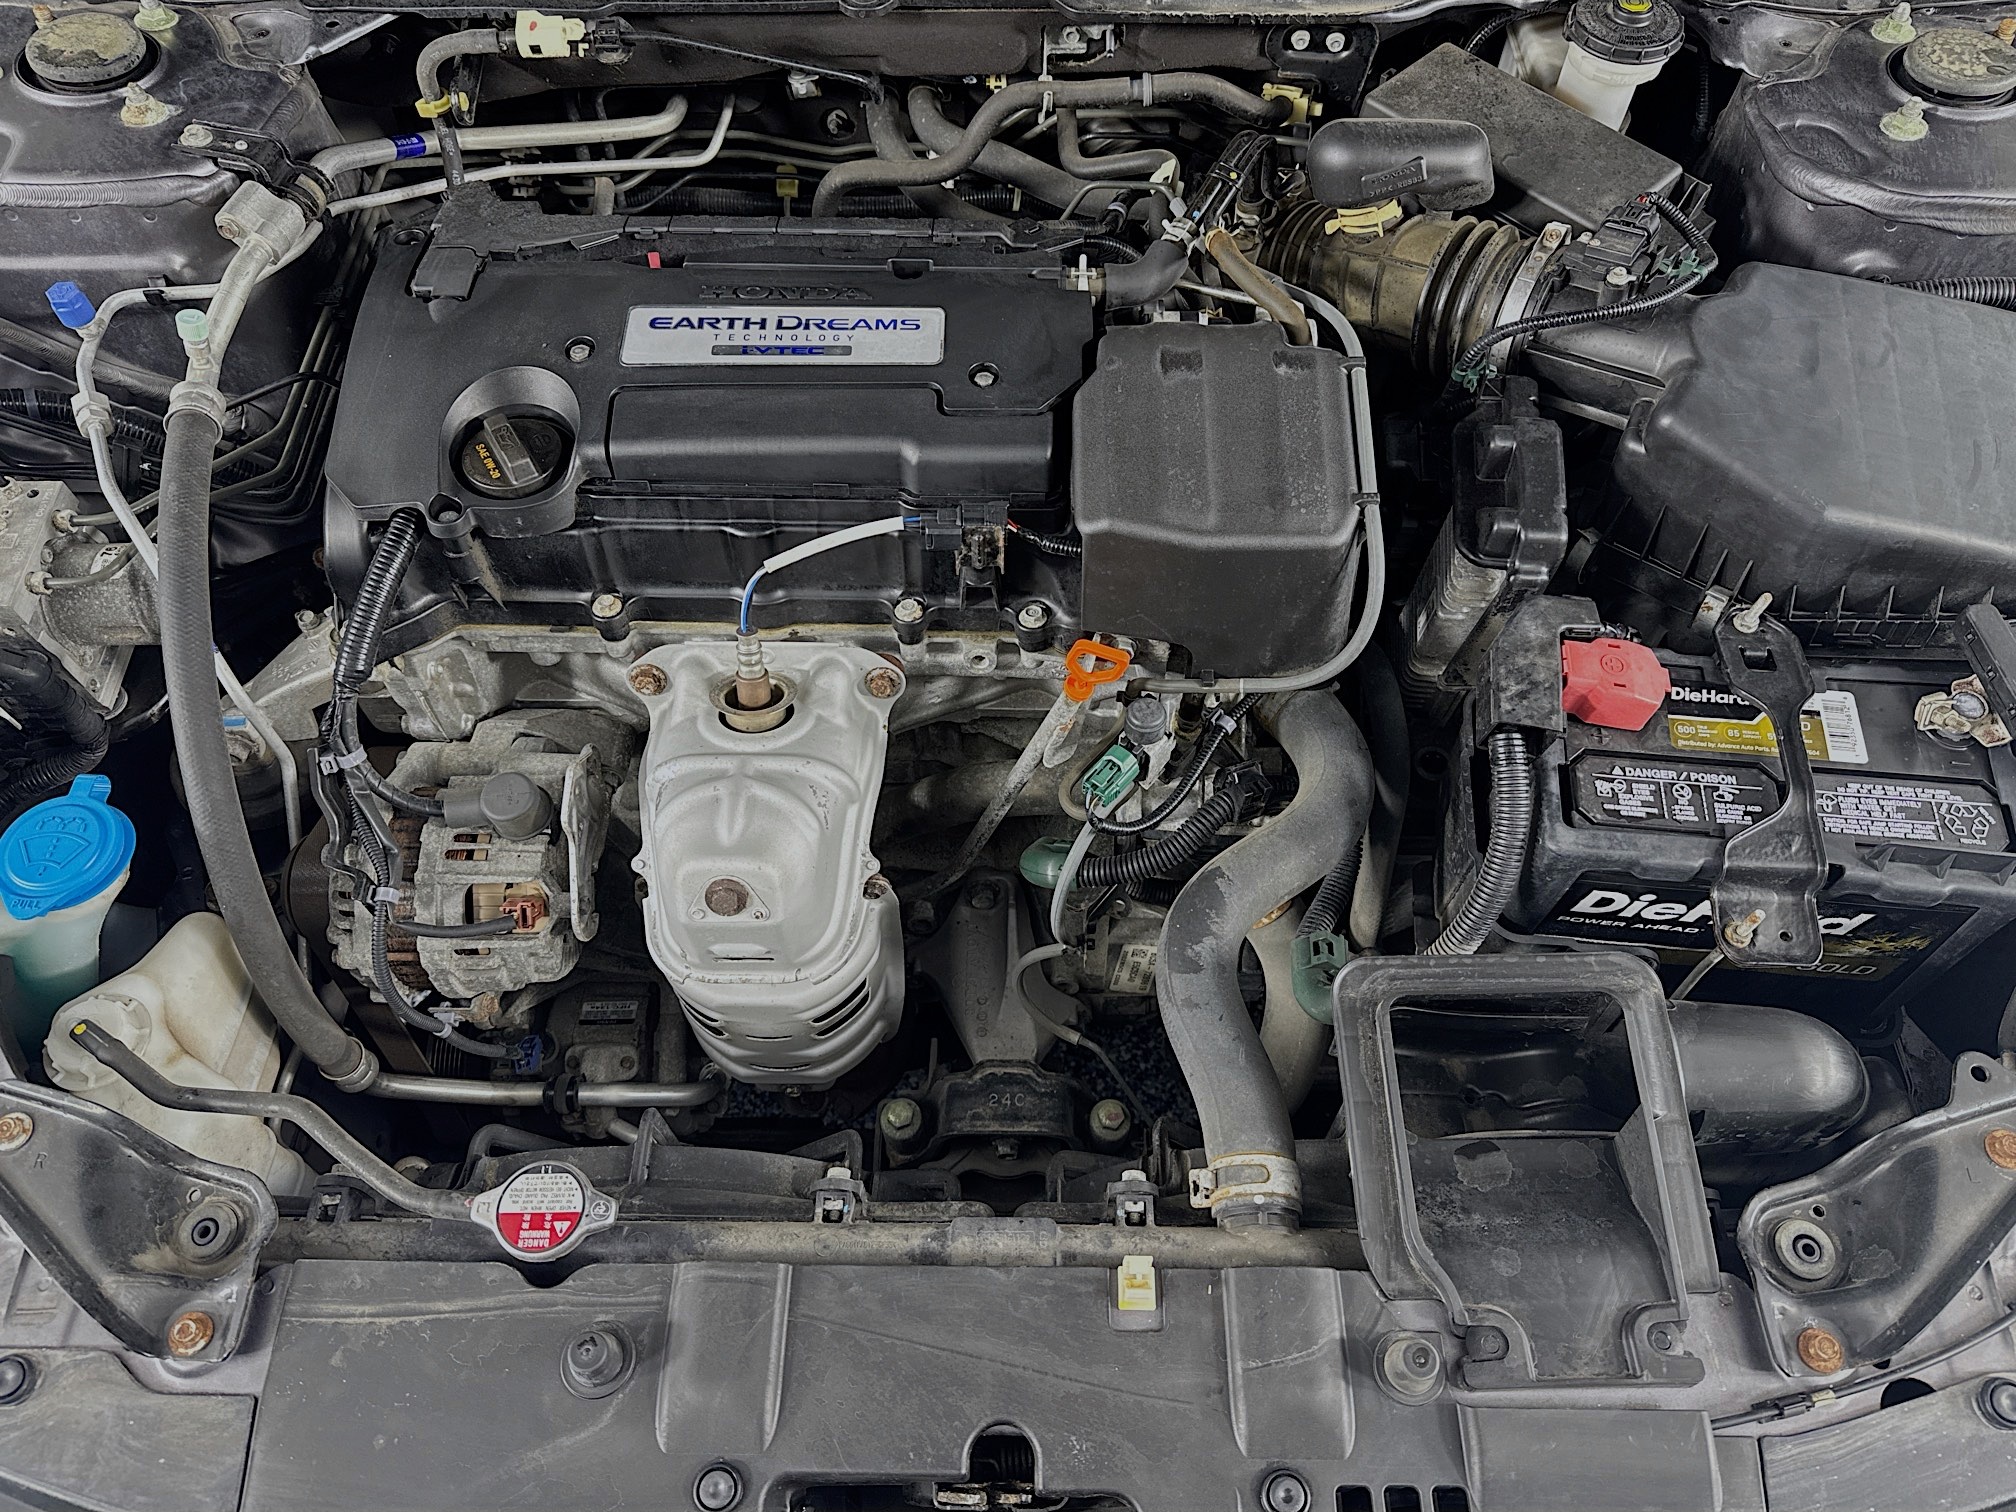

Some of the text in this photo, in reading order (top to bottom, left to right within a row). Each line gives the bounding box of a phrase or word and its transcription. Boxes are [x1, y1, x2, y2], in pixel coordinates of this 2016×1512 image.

[700, 284, 873, 300] HONDA
[649, 315, 921, 331] EARTH DREAMS
[714, 334, 855, 342] TECHNOLOGY
[741, 345, 825, 355] i-VTEC
[475, 443, 489, 459] SAE
[483, 457, 501, 479] 0W-20
[1677, 725, 1696, 734] 500
[1727, 729, 1740, 738] 85
[1677, 740, 1707, 748] Distributed
[1625, 767, 1677, 780] DANGER
[1690, 772, 1737, 785] POISON
[1632, 782, 1655, 790] SHIELD
[1618, 793, 1654, 801] EXPLOSIVE
[1838, 796, 1921, 808] FLUSH EYES IMMEDIATELY
[1714, 802, 1746, 811] SULFURIC
[1839, 802, 1857, 810] WITH
[1883, 805, 1897, 813] GET
[1841, 809, 1870, 817] MEDICAL
[11, 898, 40, 910] PULL
[1556, 915, 1700, 934] POWER AHEAD
[988, 1093, 1025, 1107] 24C
[33, 1151, 48, 1169] R
[519, 1230, 551, 1239] WARNUNG
[517, 1238, 550, 1248] DANGER
